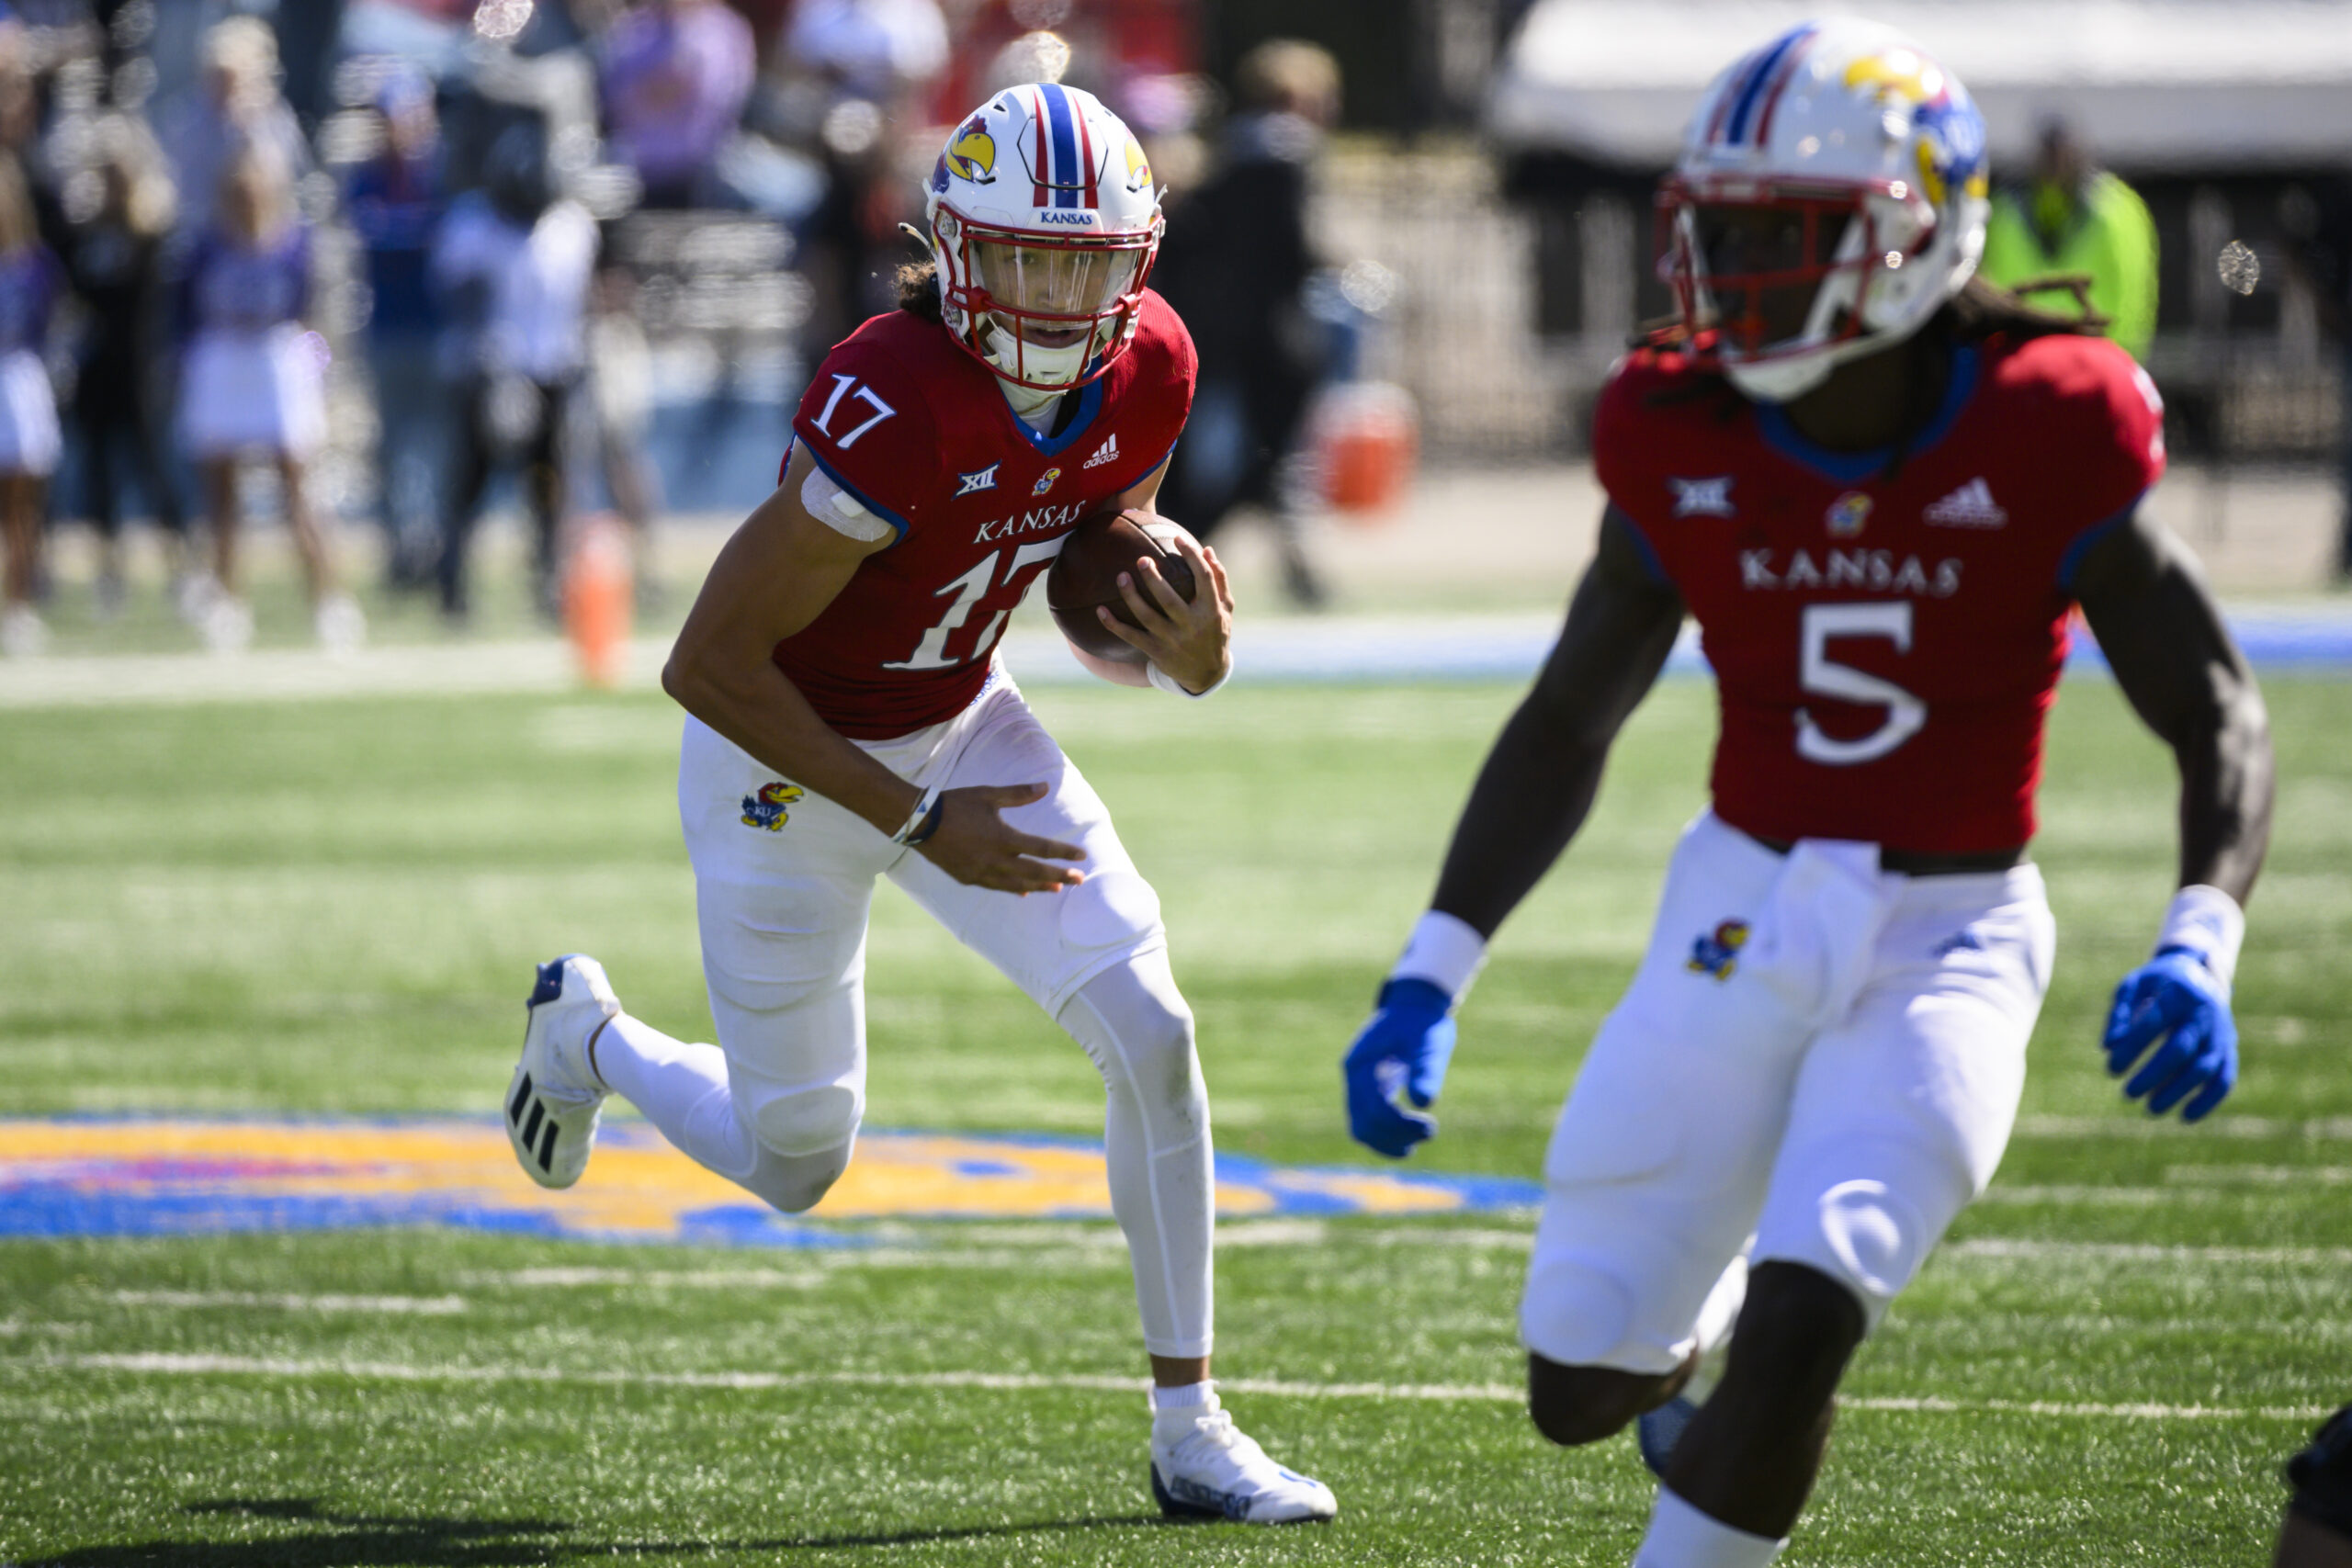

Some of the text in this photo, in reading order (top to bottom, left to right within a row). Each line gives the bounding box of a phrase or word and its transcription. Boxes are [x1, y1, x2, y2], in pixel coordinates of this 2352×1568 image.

[1041, 211, 1092, 225] KANSAS
[809, 373, 898, 451] 17
[955, 463, 1000, 497] XII
[1082, 450, 1120, 469] adidas
[973, 500, 1087, 544] KANSAS
[1740, 548, 1963, 597] KANSAS
[880, 529, 1076, 671] 17
[1795, 603, 1928, 763] 5
[754, 806, 772, 817] KU
